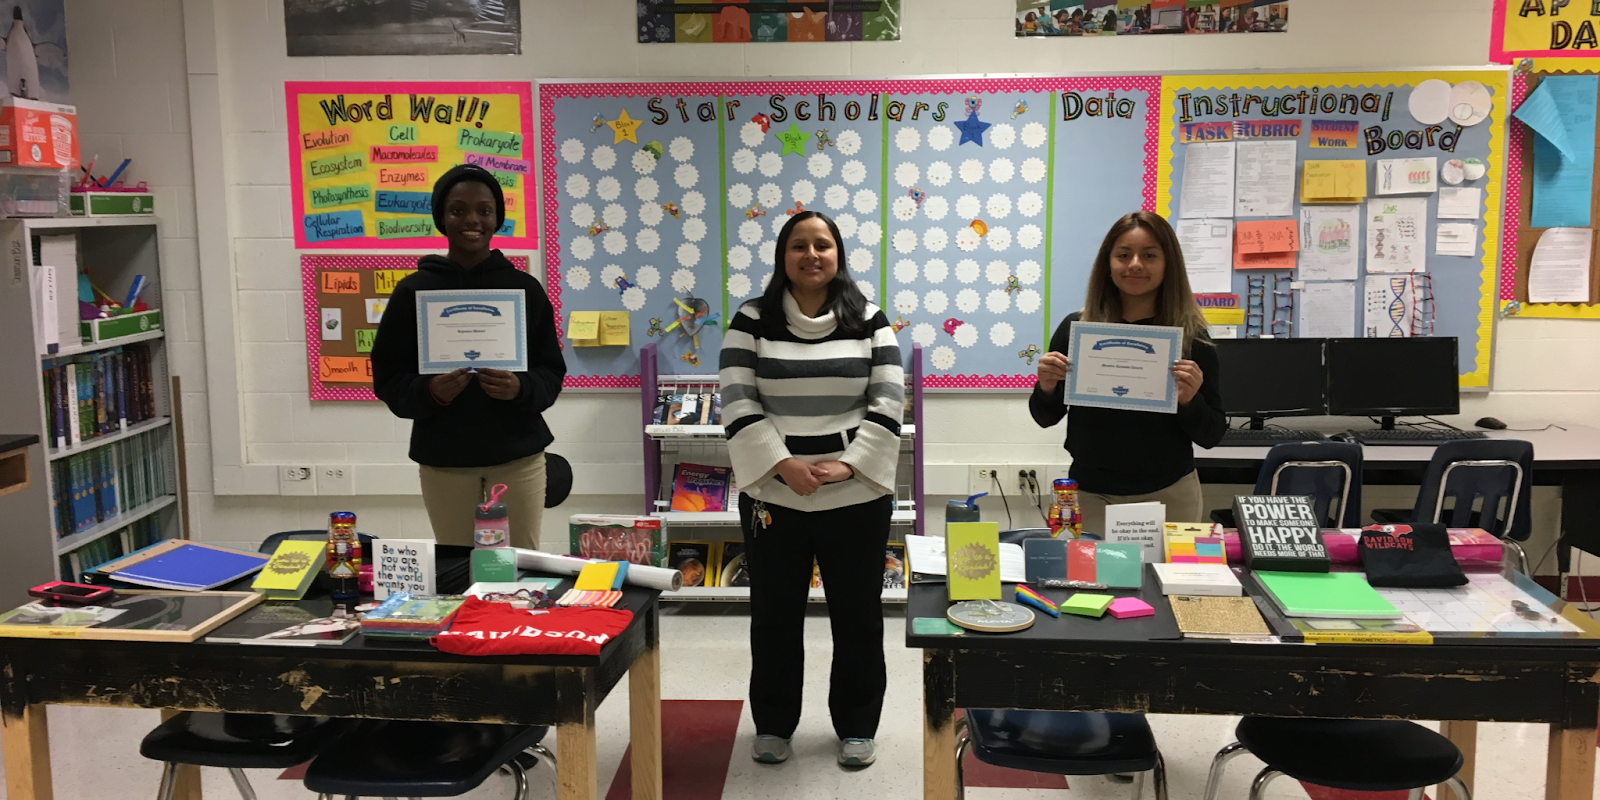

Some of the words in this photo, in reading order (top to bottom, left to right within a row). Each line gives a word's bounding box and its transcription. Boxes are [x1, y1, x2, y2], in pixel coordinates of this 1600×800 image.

[1550, 20, 1600, 50] DA
[320, 94, 394, 126] Word
[648, 96, 740, 125] Star
[770, 93, 949, 122] Scholars
[1062, 92, 1136, 121] Data
[1178, 86, 1394, 122] Instructional
[390, 126, 415, 141] Cell
[1184, 122, 1229, 140] TASK
[1236, 120, 1300, 138] RUBRIC
[1312, 120, 1358, 132] STUDENT
[303, 130, 350, 149] Evolution
[460, 129, 520, 153] Prokaryote
[1318, 136, 1348, 148] WORK
[1364, 124, 1464, 156] Board
[372, 148, 436, 160] Macromolecules
[311, 158, 362, 177] Ecosystem
[467, 154, 484, 166] Cell
[486, 157, 527, 172] Membrane
[380, 169, 425, 185] Enzymes
[312, 187, 369, 205] Photosynthesis
[378, 194, 432, 212] Eukaryote
[304, 216, 341, 228] Cellular
[379, 220, 432, 236] Biodiversity
[315, 224, 364, 239] Respiration
[325, 273, 357, 292] Lipids
[322, 357, 358, 377] Smooth
[682, 470, 710, 478] Energy
[687, 477, 725, 486] Transfers
[1241, 504, 1313, 520] POWER
[1248, 527, 1317, 544] HAPPY
[1363, 535, 1413, 545] DAVIDSON
[382, 544, 394, 554] Be
[397, 545, 417, 556] who
[1364, 542, 1414, 551] WILDCATS
[380, 556, 398, 565] you
[401, 557, 419, 566] are,
[382, 564, 396, 572] not
[399, 562, 419, 573] who
[378, 571, 393, 580] the
[396, 572, 423, 582] world
[377, 581, 404, 590] wants
[408, 583, 424, 594] you
